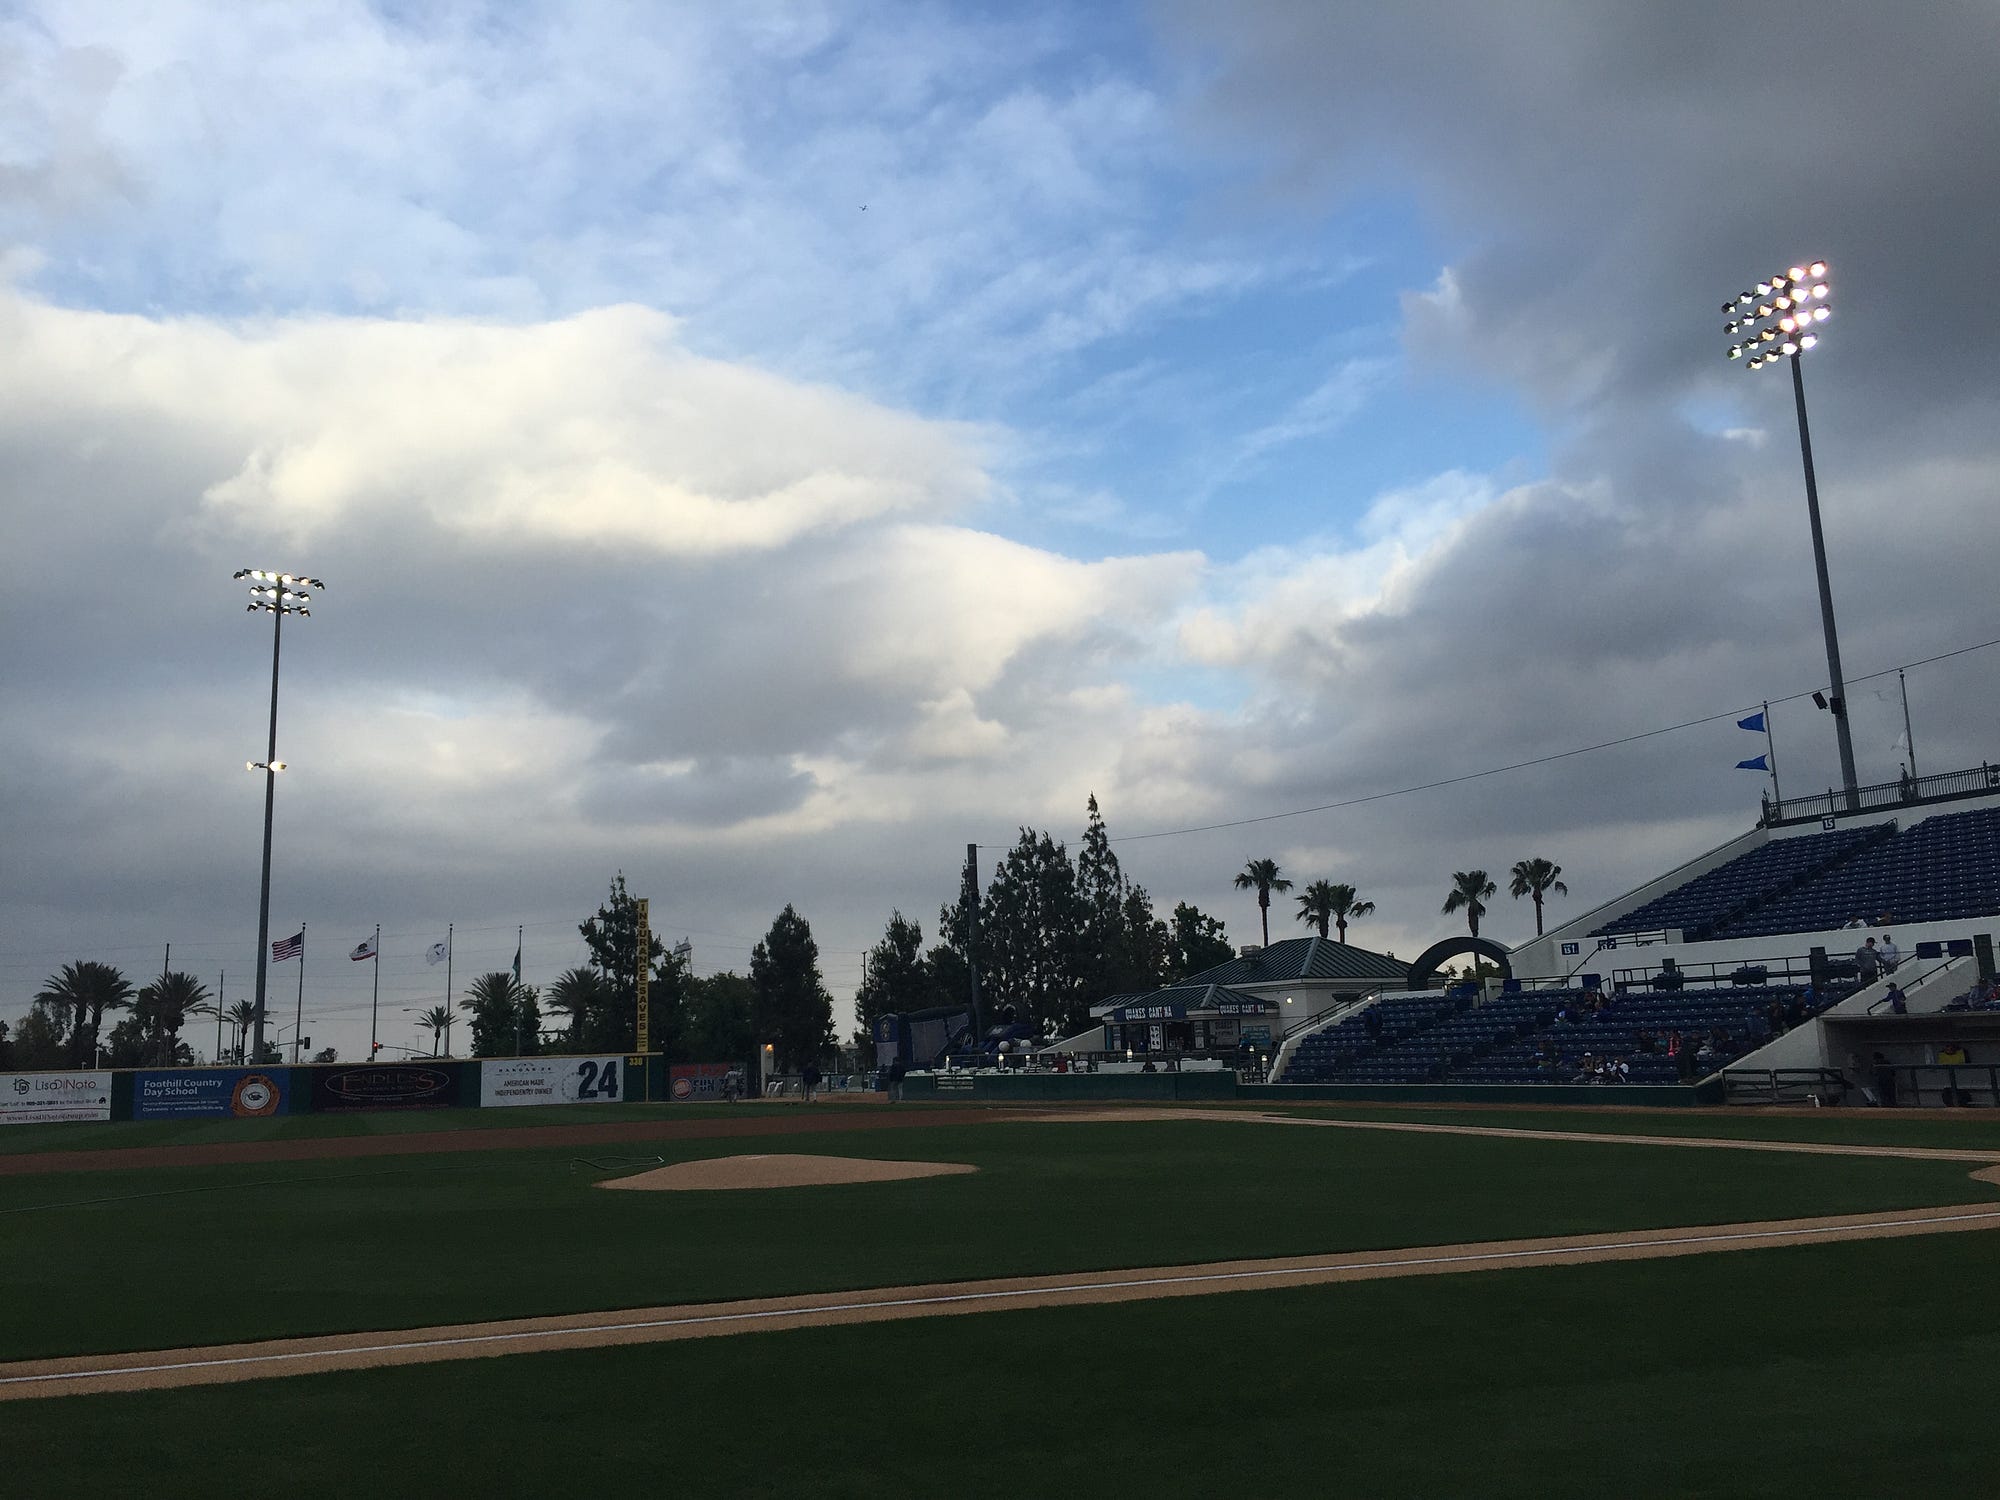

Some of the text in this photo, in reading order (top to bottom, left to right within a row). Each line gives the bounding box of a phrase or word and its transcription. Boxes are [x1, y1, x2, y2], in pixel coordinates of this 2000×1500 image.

[1825, 819, 1834, 828] 15
[638, 903, 648, 982] INSURANCE
[637, 986, 648, 1031] SAVES
[1125, 1007, 1146, 1021] QUAKES
[1220, 1004, 1240, 1015] QUAKES
[144, 1078, 223, 1089] Foothill Country
[503, 1078, 545, 1087] AMERICAN MADE
[578, 1061, 618, 1099] 24
[143, 1086, 198, 1097] Day School
[495, 1087, 553, 1097] INDEPENDENTLY OWNED
